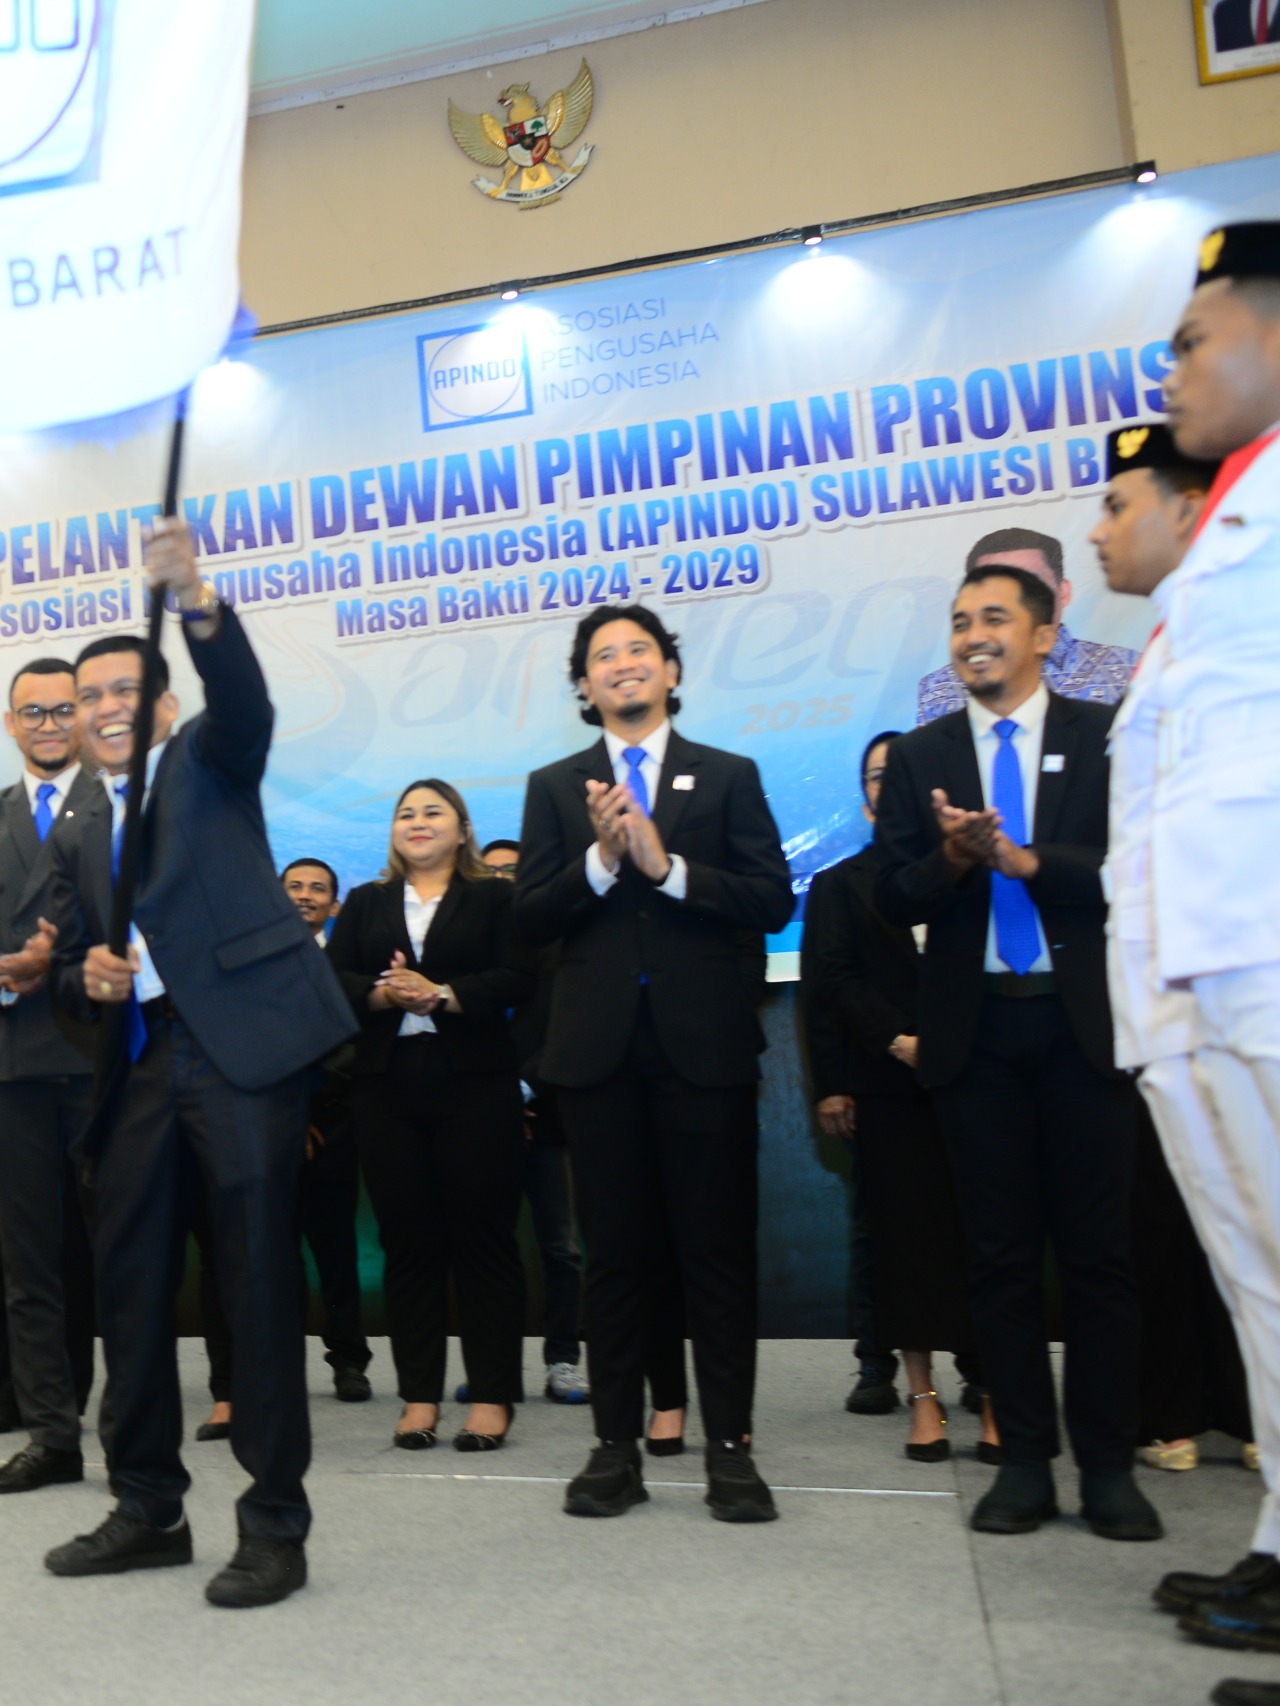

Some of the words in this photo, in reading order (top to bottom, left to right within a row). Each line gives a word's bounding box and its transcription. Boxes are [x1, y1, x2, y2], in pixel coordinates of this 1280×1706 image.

[8, 227, 189, 308] BARAT
[538, 298, 666, 336] ASOSIASI
[541, 323, 720, 371] PENGUSAHA
[433, 357, 517, 391] APINDO
[544, 360, 700, 403] INDONESIA
[309, 444, 519, 540] DEWAN
[534, 390, 854, 505] PIMPINAN
[372, 518, 586, 585] Indonesia
[601, 479, 799, 553] (APINDO)
[812, 443, 1052, 523] SULAWESI
[336, 594, 428, 638] Masa
[439, 575, 531, 624] Bakti
[541, 563, 630, 609] 2024
[663, 543, 761, 595] 2029
[738, 694, 855, 736] 2025
